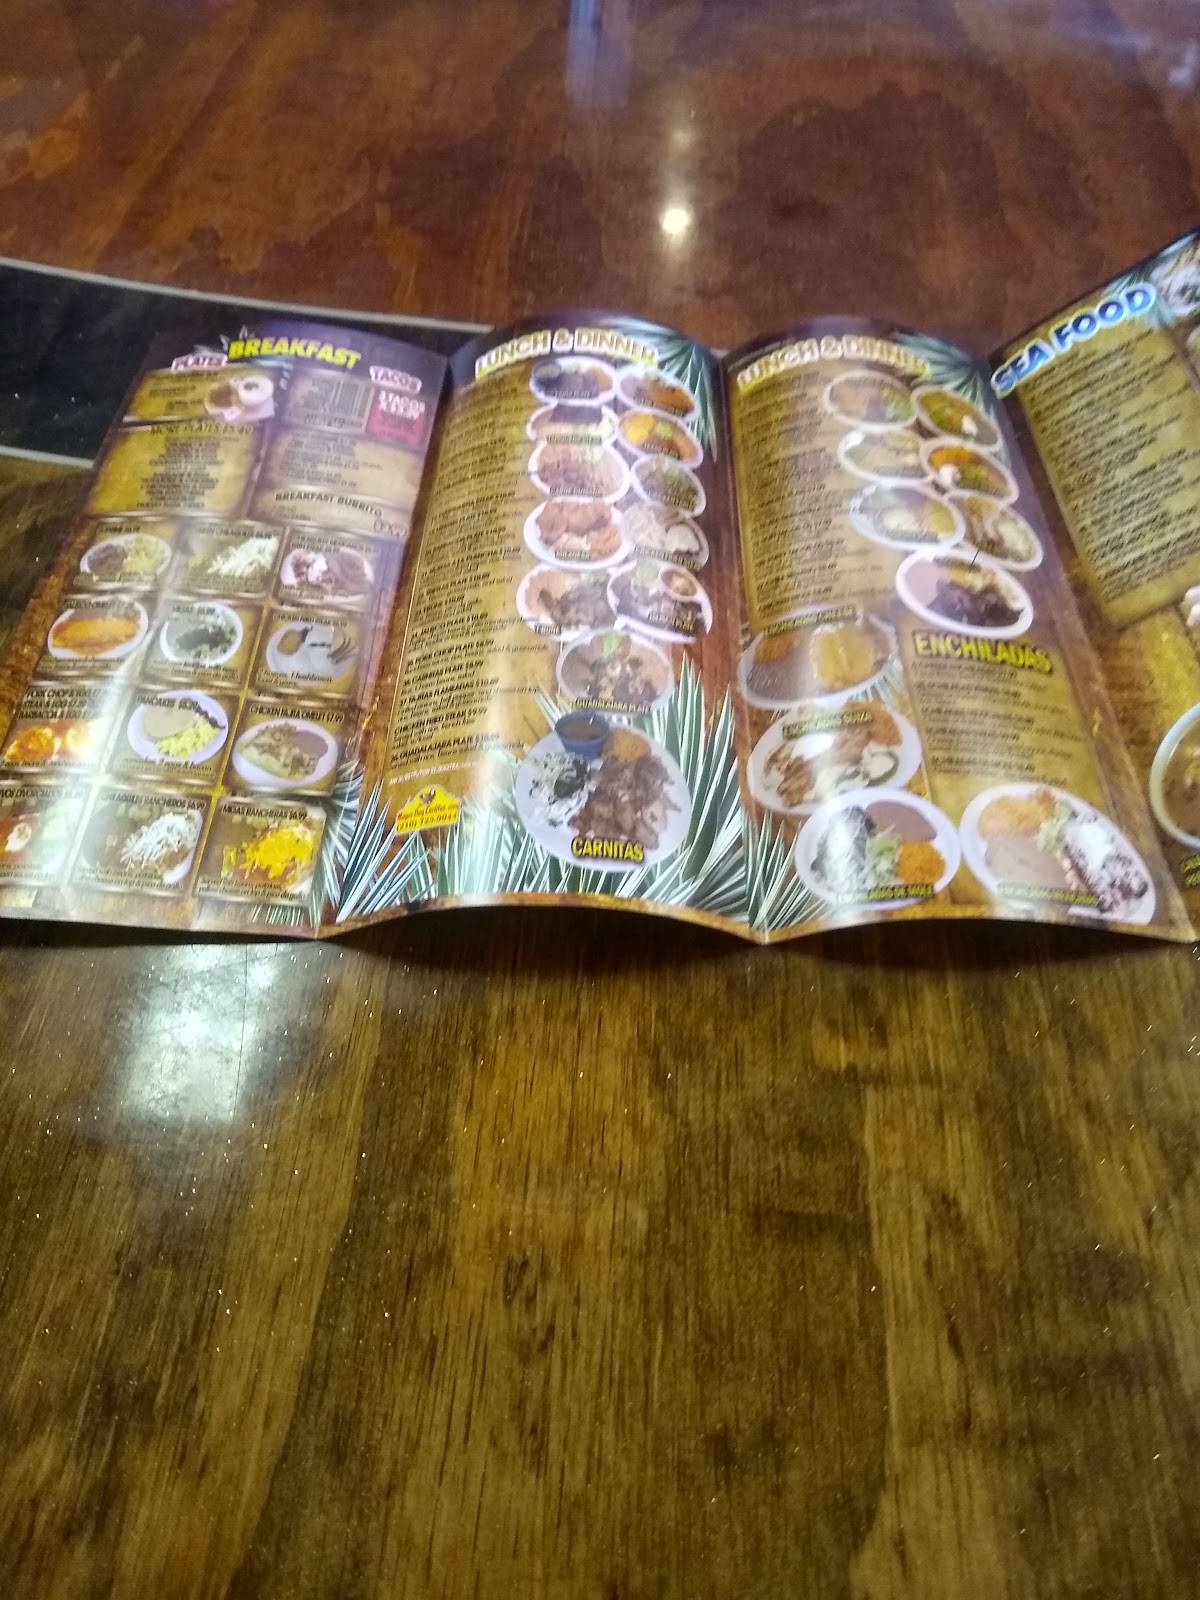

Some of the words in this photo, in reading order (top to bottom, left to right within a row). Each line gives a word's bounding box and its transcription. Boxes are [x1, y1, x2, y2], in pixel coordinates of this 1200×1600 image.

[228, 336, 362, 369] BREAKFAST
[475, 330, 552, 378] LUNCH
[553, 327, 573, 351] &
[574, 328, 659, 368] DINNER
[993, 343, 1052, 397] SEA
[1053, 285, 1154, 351] FOOD
[371, 366, 421, 394] TACOS
[737, 337, 819, 391] LUNCH
[820, 335, 843, 359] &
[275, 490, 335, 505] BREAKFAST
[337, 497, 383, 517] BURRITO
[914, 631, 1054, 675] ENCHILADAS
[570, 836, 645, 862] CARNITAS
